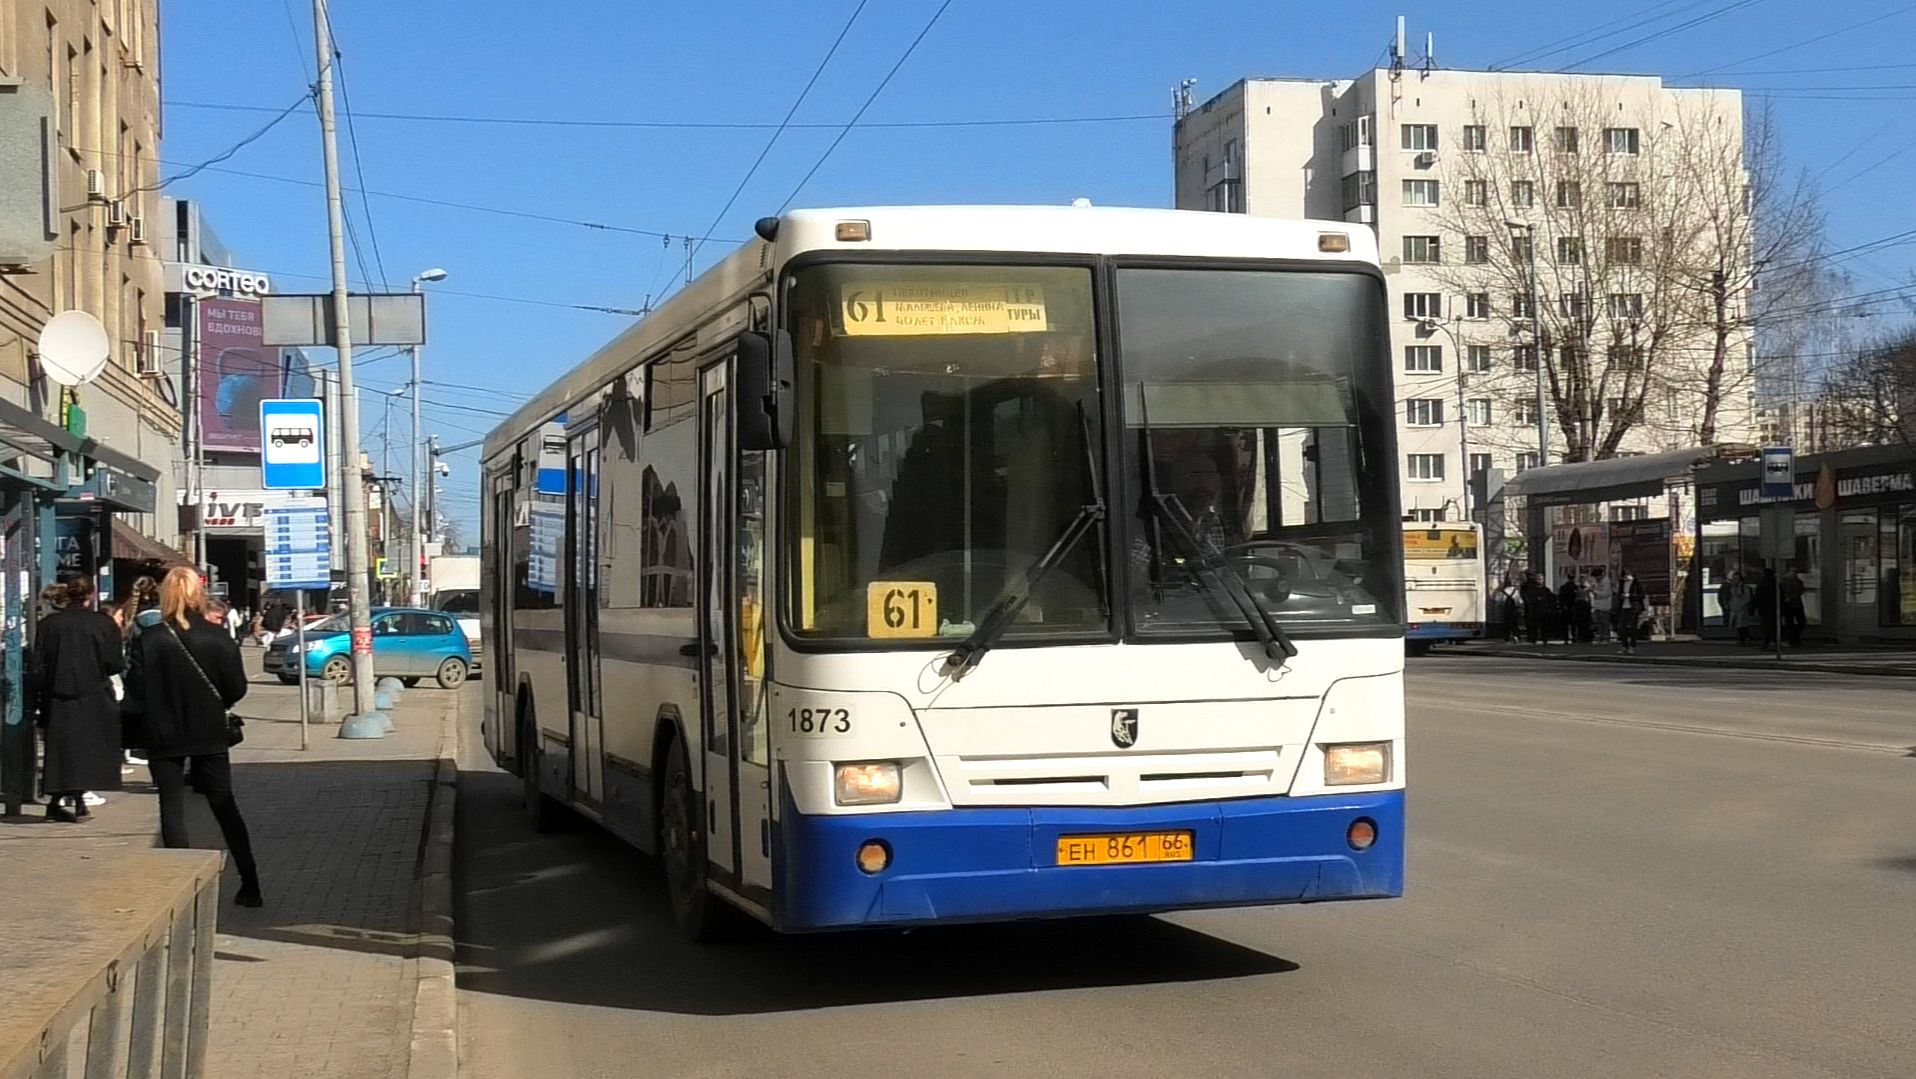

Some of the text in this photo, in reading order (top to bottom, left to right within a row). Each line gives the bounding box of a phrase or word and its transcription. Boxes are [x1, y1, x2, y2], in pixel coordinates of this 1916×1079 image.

[207, 307, 255, 321] МЫ ТЕБЯ
[846, 290, 887, 323] 61
[207, 322, 263, 337] ВДОХНОВ
[1739, 482, 1814, 506] ШАКИ
[1837, 472, 1913, 497] ШАВЕРМА
[883, 588, 920, 629] 61
[788, 707, 851, 733] 1873
[1107, 832, 1148, 858] 861
[1162, 832, 1184, 850] 66
